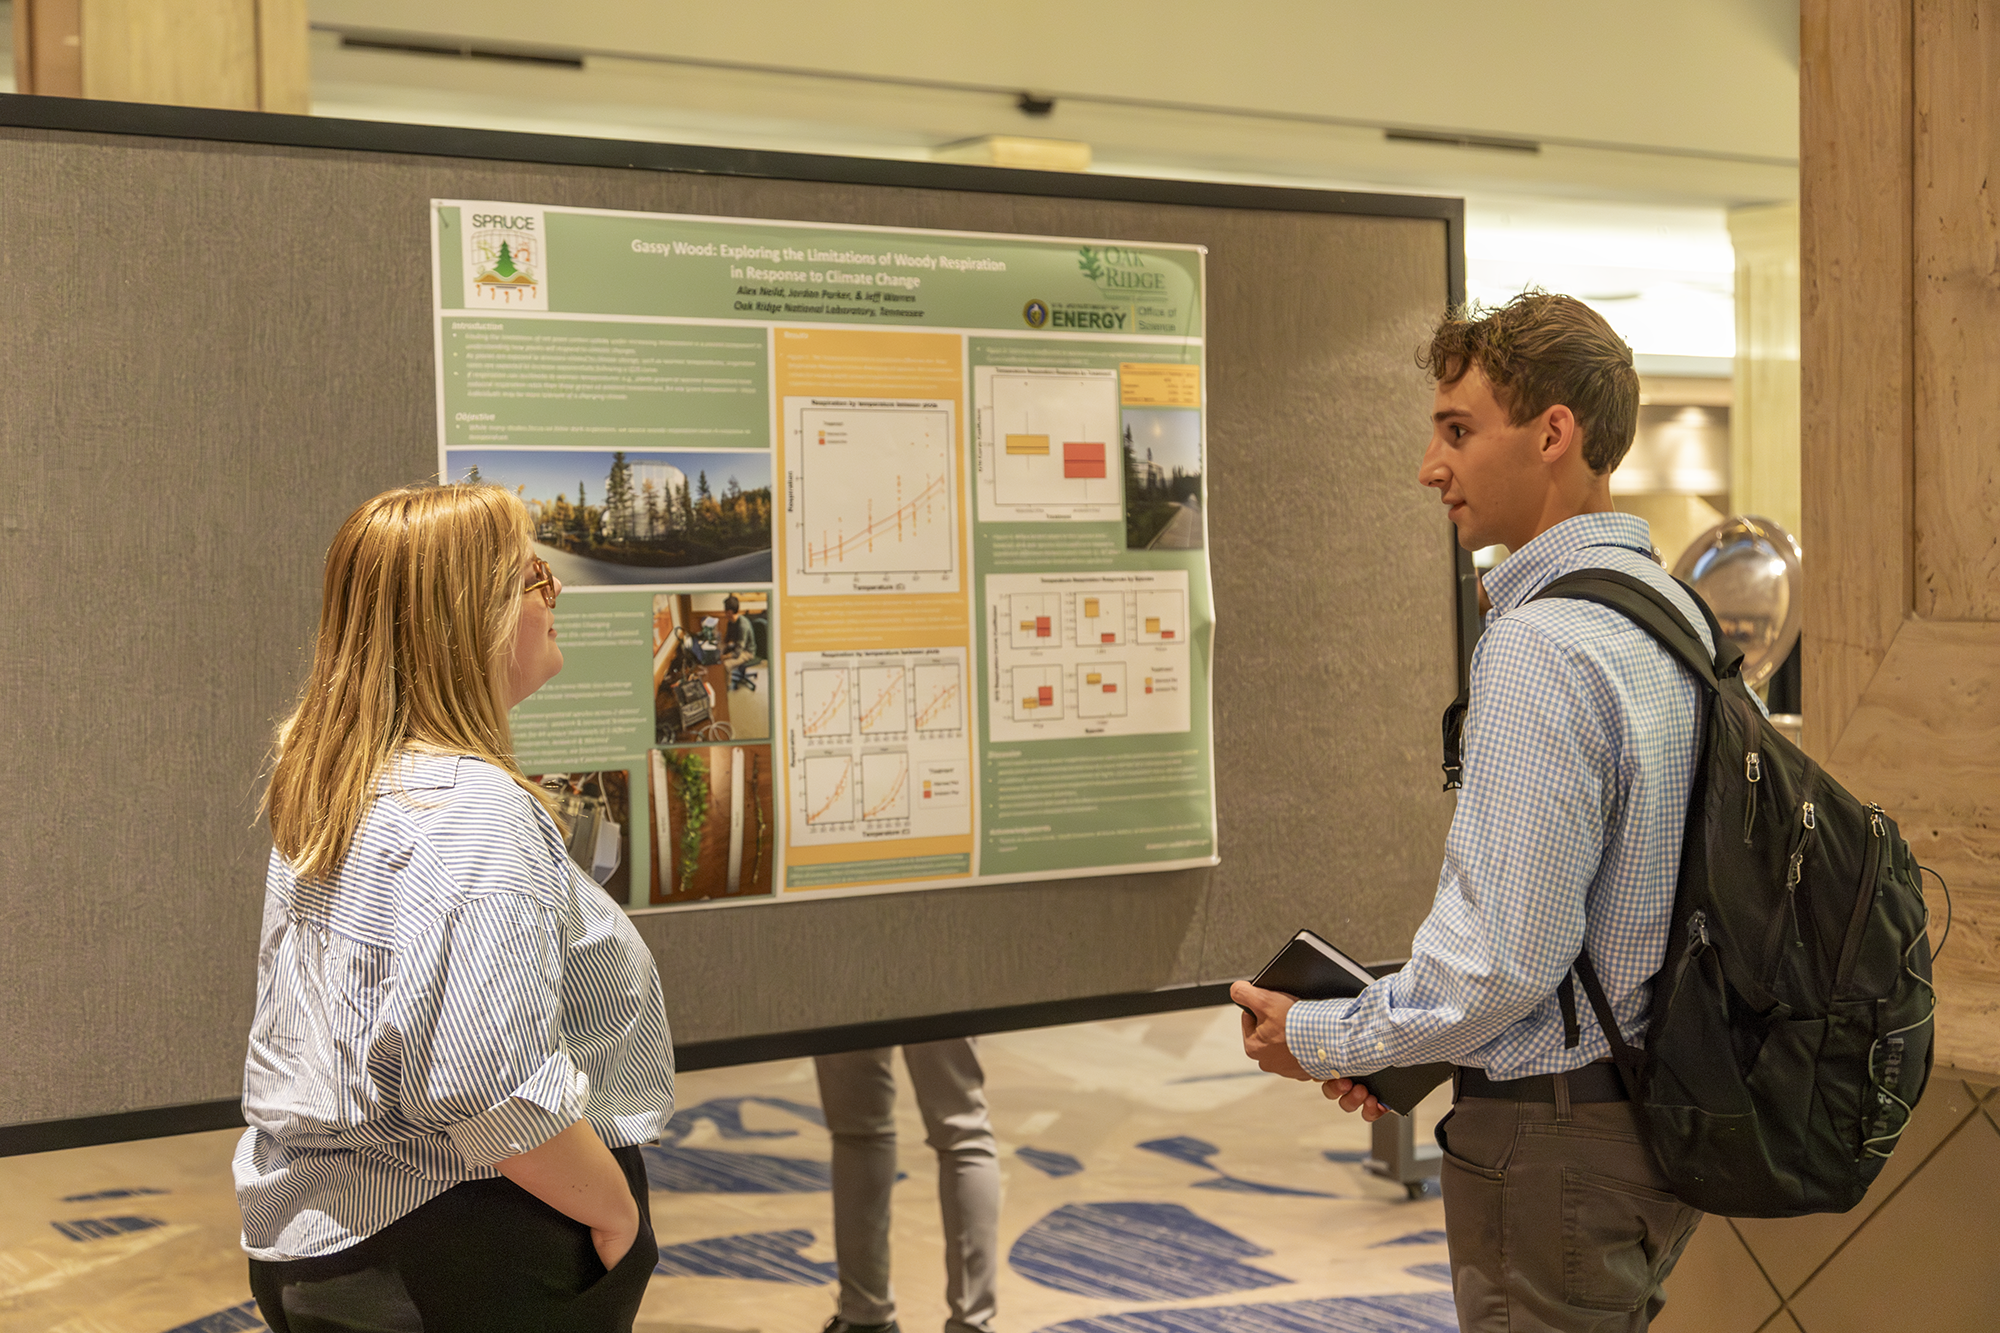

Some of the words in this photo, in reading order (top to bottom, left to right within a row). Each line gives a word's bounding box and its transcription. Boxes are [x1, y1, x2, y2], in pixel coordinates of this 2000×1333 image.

[472, 213, 535, 230] SPRUCE
[631, 239, 670, 257] Gassy
[673, 241, 717, 256] Wood:
[719, 244, 781, 263] Exploring
[782, 247, 804, 261] the
[807, 248, 876, 265] Limitations
[878, 252, 891, 266] of
[894, 253, 937, 270] Woody
[939, 255, 1006, 272] Respiration
[1104, 246, 1144, 267] OAK
[730, 265, 743, 279] in
[746, 266, 807, 283] Response
[809, 269, 823, 283] to
[825, 270, 873, 285] Climate
[875, 272, 921, 290] Change
[1105, 267, 1166, 289] RIDGE
[736, 286, 757, 296] Alex
[787, 288, 819, 299] Jordan
[855, 290, 863, 300] &
[864, 291, 881, 303] Jeff
[733, 301, 753, 311] Oak
[755, 301, 782, 314] Ridge
[784, 302, 824, 314] National
[879, 306, 925, 317] Tennessee
[1138, 306, 1165, 317] Office
[1168, 307, 1177, 318] of
[452, 321, 503, 331] Introduction
[1052, 310, 1127, 329] ENERGY
[1138, 320, 1176, 331] Science
[455, 411, 495, 422] Objective
